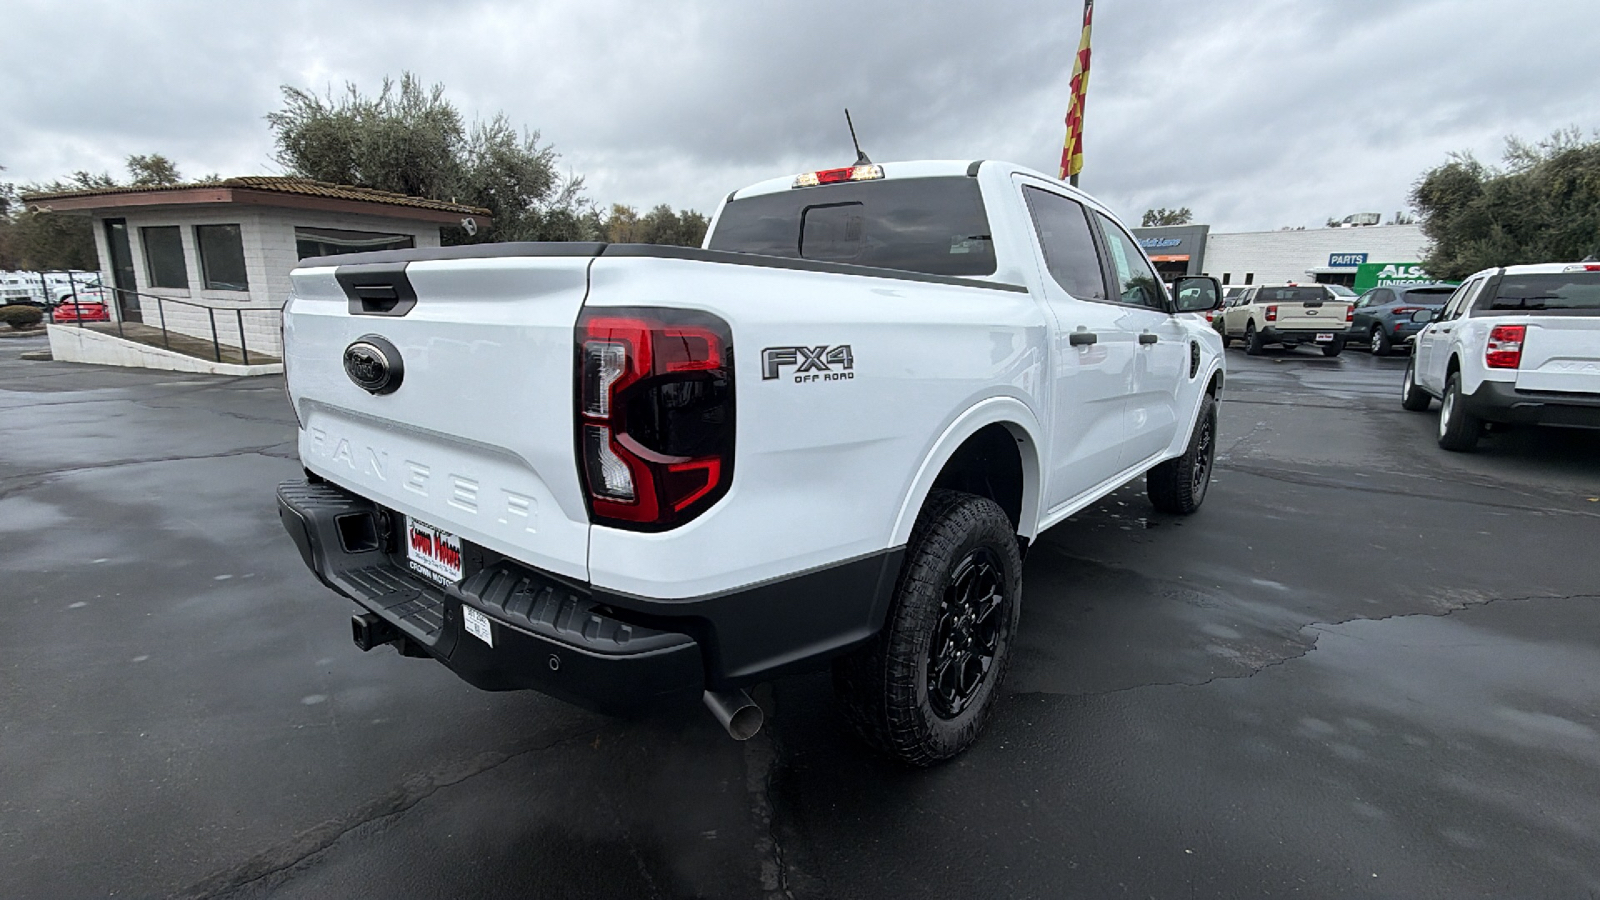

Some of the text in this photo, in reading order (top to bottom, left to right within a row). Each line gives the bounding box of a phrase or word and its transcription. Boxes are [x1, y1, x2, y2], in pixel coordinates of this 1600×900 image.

[1330, 255, 1363, 265] PARTS
[1377, 264, 1430, 279] ALS
[761, 345, 854, 380] FX4
[794, 372, 854, 383] OFF ROAD
[311, 426, 539, 534] RANGER
[409, 521, 433, 558] Crown
[433, 529, 461, 572] Motors
[409, 561, 432, 579] CROWN
[432, 572, 454, 587] MOTO
